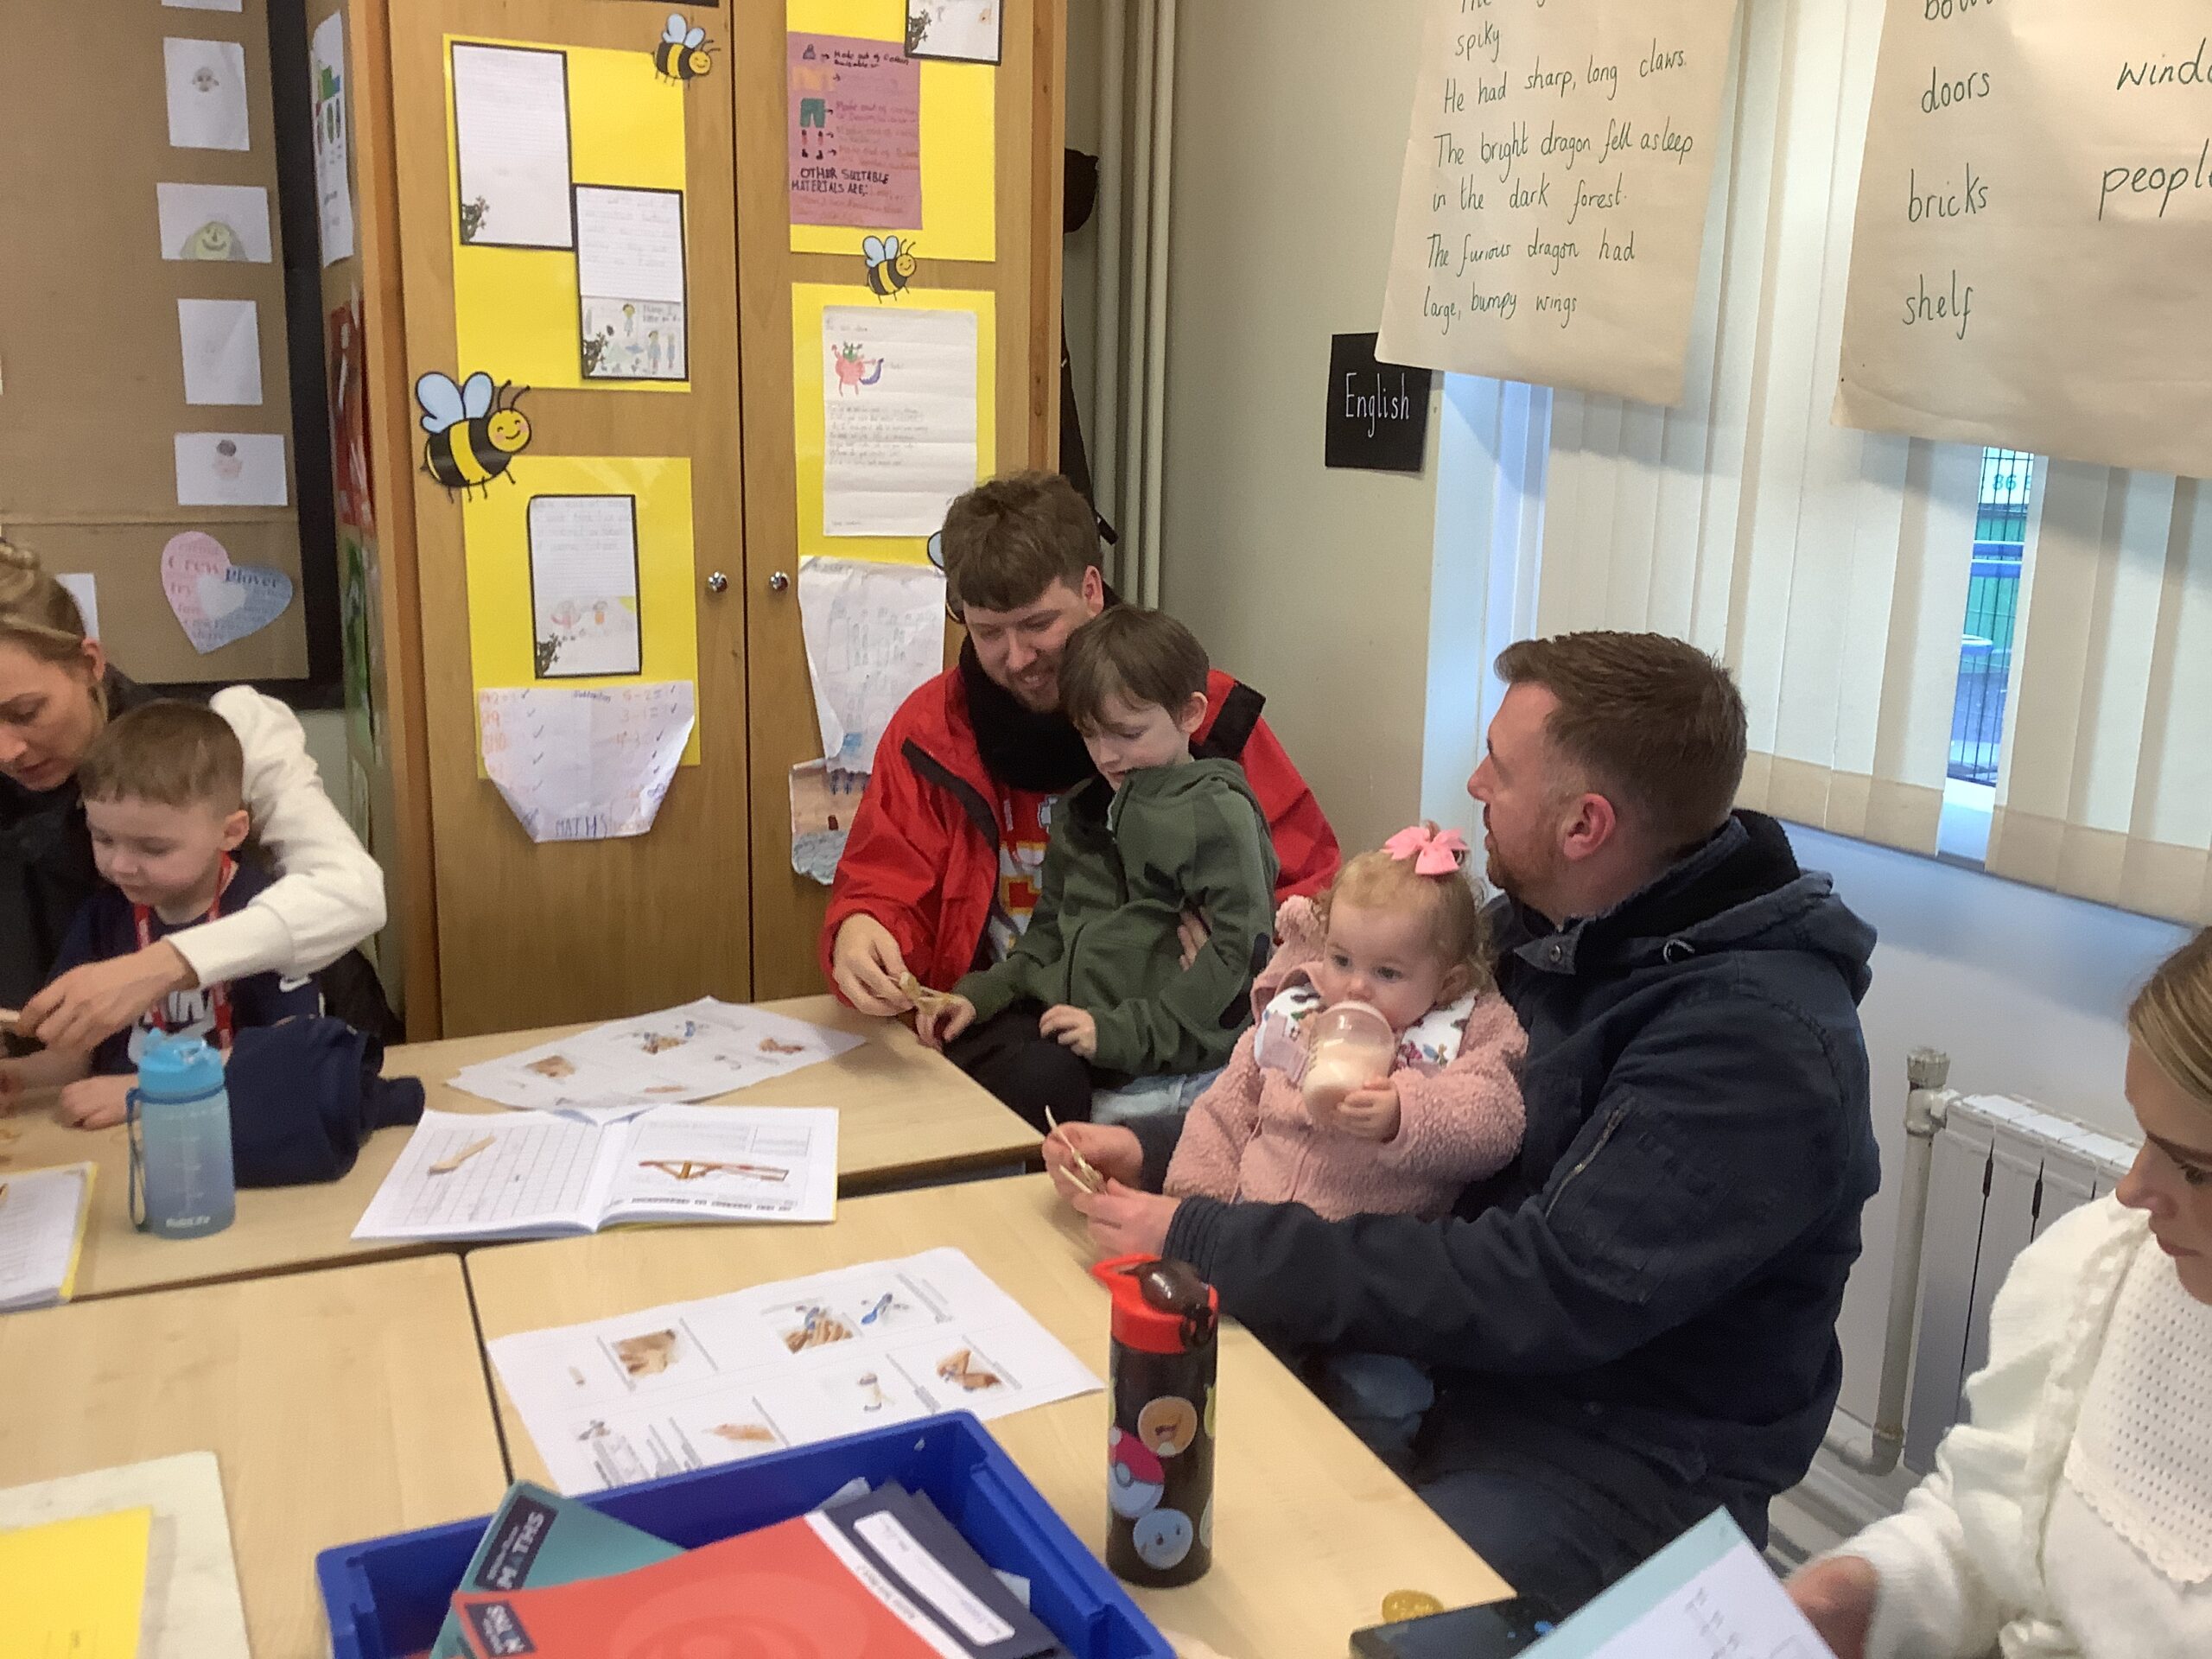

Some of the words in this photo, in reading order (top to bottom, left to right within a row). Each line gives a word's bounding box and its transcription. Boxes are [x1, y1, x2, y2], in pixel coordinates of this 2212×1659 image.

[1454, 21, 1500, 63] spiky
[2116, 36, 2212, 91] wind
[1444, 78, 1465, 114] He
[1478, 71, 1508, 105] had
[1524, 55, 1577, 99] sharp,
[1586, 54, 1618, 101] long
[1639, 38, 1688, 78] claws.
[1921, 67, 1991, 114] doors
[800, 167, 838, 180] OTHER
[841, 168, 890, 184] SUITABLE
[1433, 132, 1465, 168] The
[1480, 121, 1529, 184] bright
[1541, 120, 1592, 170] dragon
[1599, 118, 1634, 164] fell
[1640, 116, 1694, 166] asleep
[1433, 192, 1446, 213] in
[1459, 175, 1484, 211] the
[1509, 173, 1551, 208] dark
[1567, 172, 1629, 225] forest.
[1908, 162, 1990, 224] bricks
[1427, 233, 1450, 269] The
[1455, 234, 1512, 277] furious
[1527, 227, 1580, 276] dragon
[1599, 228, 1636, 261] had
[1423, 286, 1462, 336] large,
[1471, 282, 1517, 321] bumpy
[1535, 293, 1578, 329] wings
[1902, 270, 1974, 340] shelf
[1344, 372, 1410, 438] English
